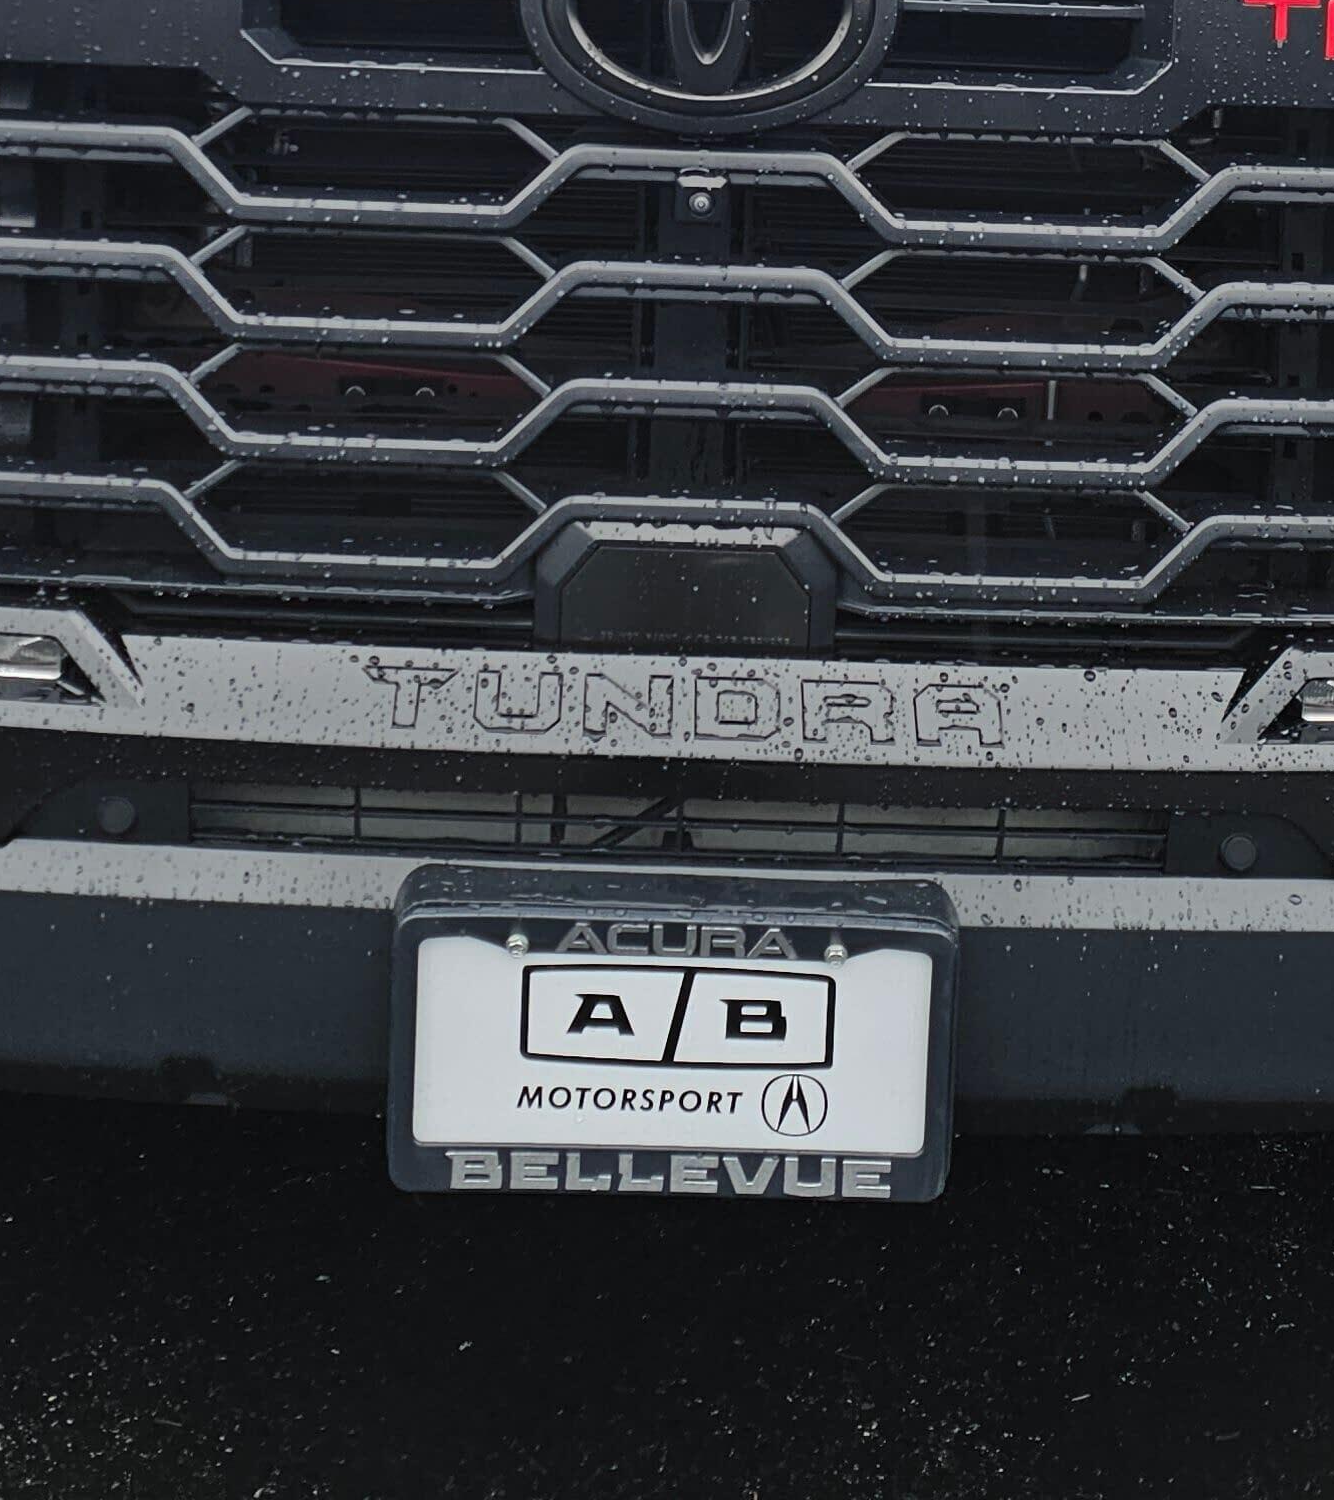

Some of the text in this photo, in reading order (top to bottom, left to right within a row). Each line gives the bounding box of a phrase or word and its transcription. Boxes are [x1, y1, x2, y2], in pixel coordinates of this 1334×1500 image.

[363, 664, 1005, 749] TUNDRA
[554, 921, 798, 960] ACURA
[516, 1085, 744, 1114] MOTORSPORT
[445, 1150, 892, 1199] BELLEVUE
